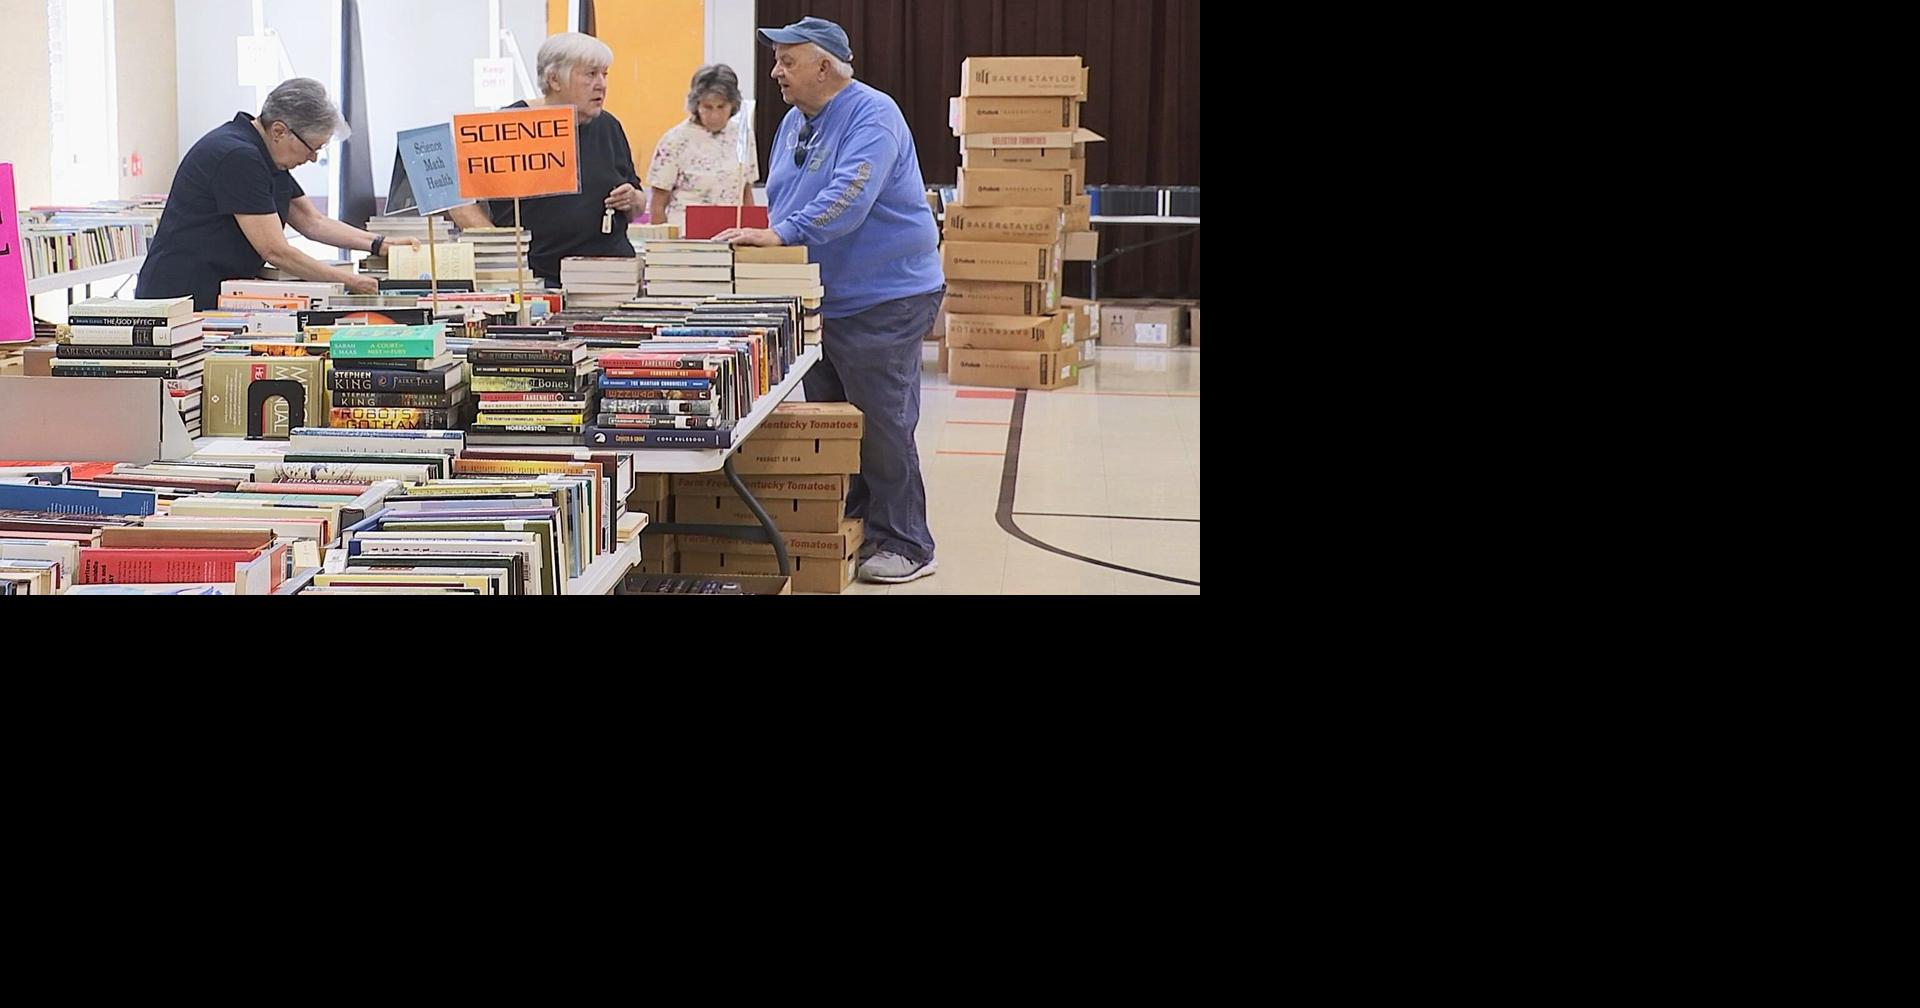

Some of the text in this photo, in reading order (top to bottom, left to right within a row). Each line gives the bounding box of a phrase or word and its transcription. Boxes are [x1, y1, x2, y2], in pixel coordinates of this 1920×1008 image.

[460, 119, 569, 143] SCIENCE
[413, 141, 443, 156] Science
[422, 158, 446, 172] Math
[468, 151, 566, 174] FICTION
[425, 174, 454, 190] Health
[966, 221, 1050, 230] BAKER&TAYLOR
[103, 317, 115, 325] THE
[133, 318, 156, 326] EFFECT
[641, 360, 674, 368] FAHRENHEIT
[334, 371, 372, 379] STEPHEN
[335, 379, 372, 390] KING
[538, 378, 569, 388] Bones
[341, 398, 376, 407] KING
[341, 408, 412, 420] ROBOTS
[346, 420, 420, 429] GOTHAM
[760, 420, 859, 431] Kentucky Tomatoes
[787, 481, 836, 491] Tomatoes
[790, 539, 839, 549] Tomatoes
